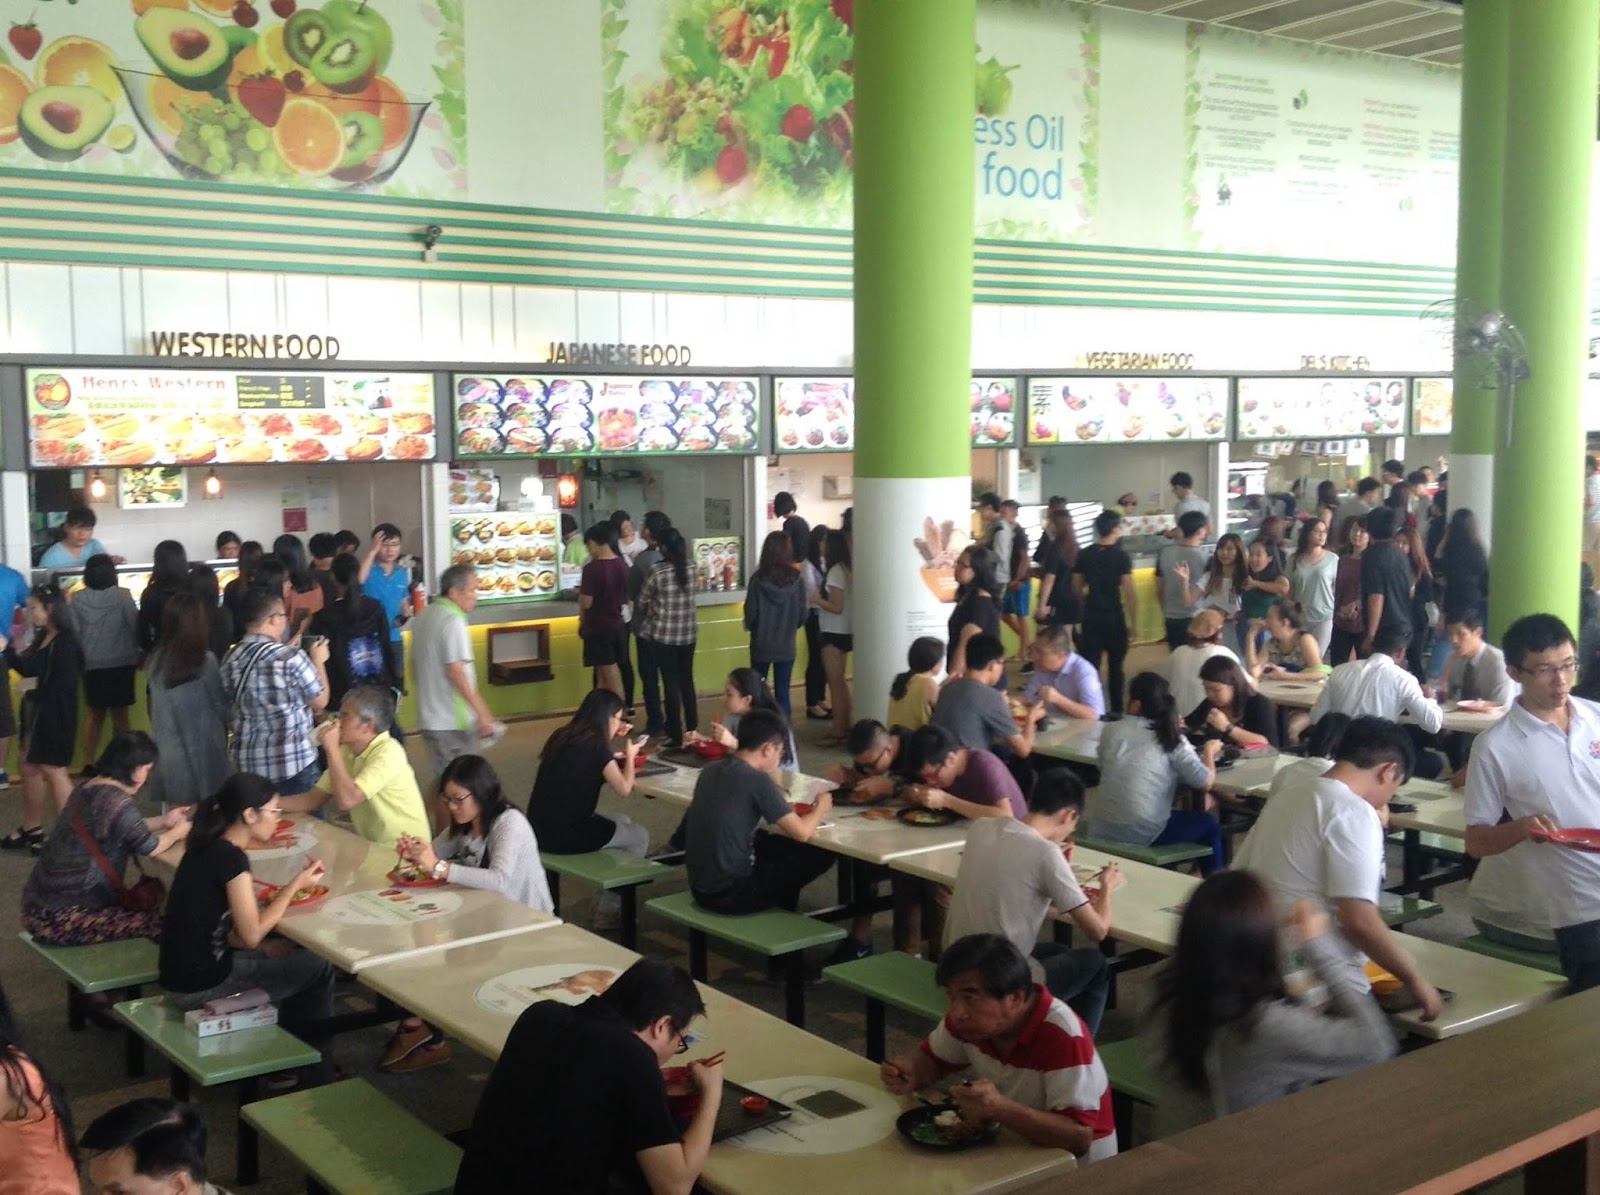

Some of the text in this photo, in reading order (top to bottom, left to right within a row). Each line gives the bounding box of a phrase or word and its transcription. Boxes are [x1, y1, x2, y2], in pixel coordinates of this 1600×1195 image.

[1026, 113, 1064, 151] Oil
[983, 150, 1062, 200] food
[152, 331, 340, 360] WESTERN FOOD
[546, 341, 691, 366] JAPANESE FOOD
[1086, 351, 1160, 369] VEGETARIAN
[149, 377, 226, 390] Western
